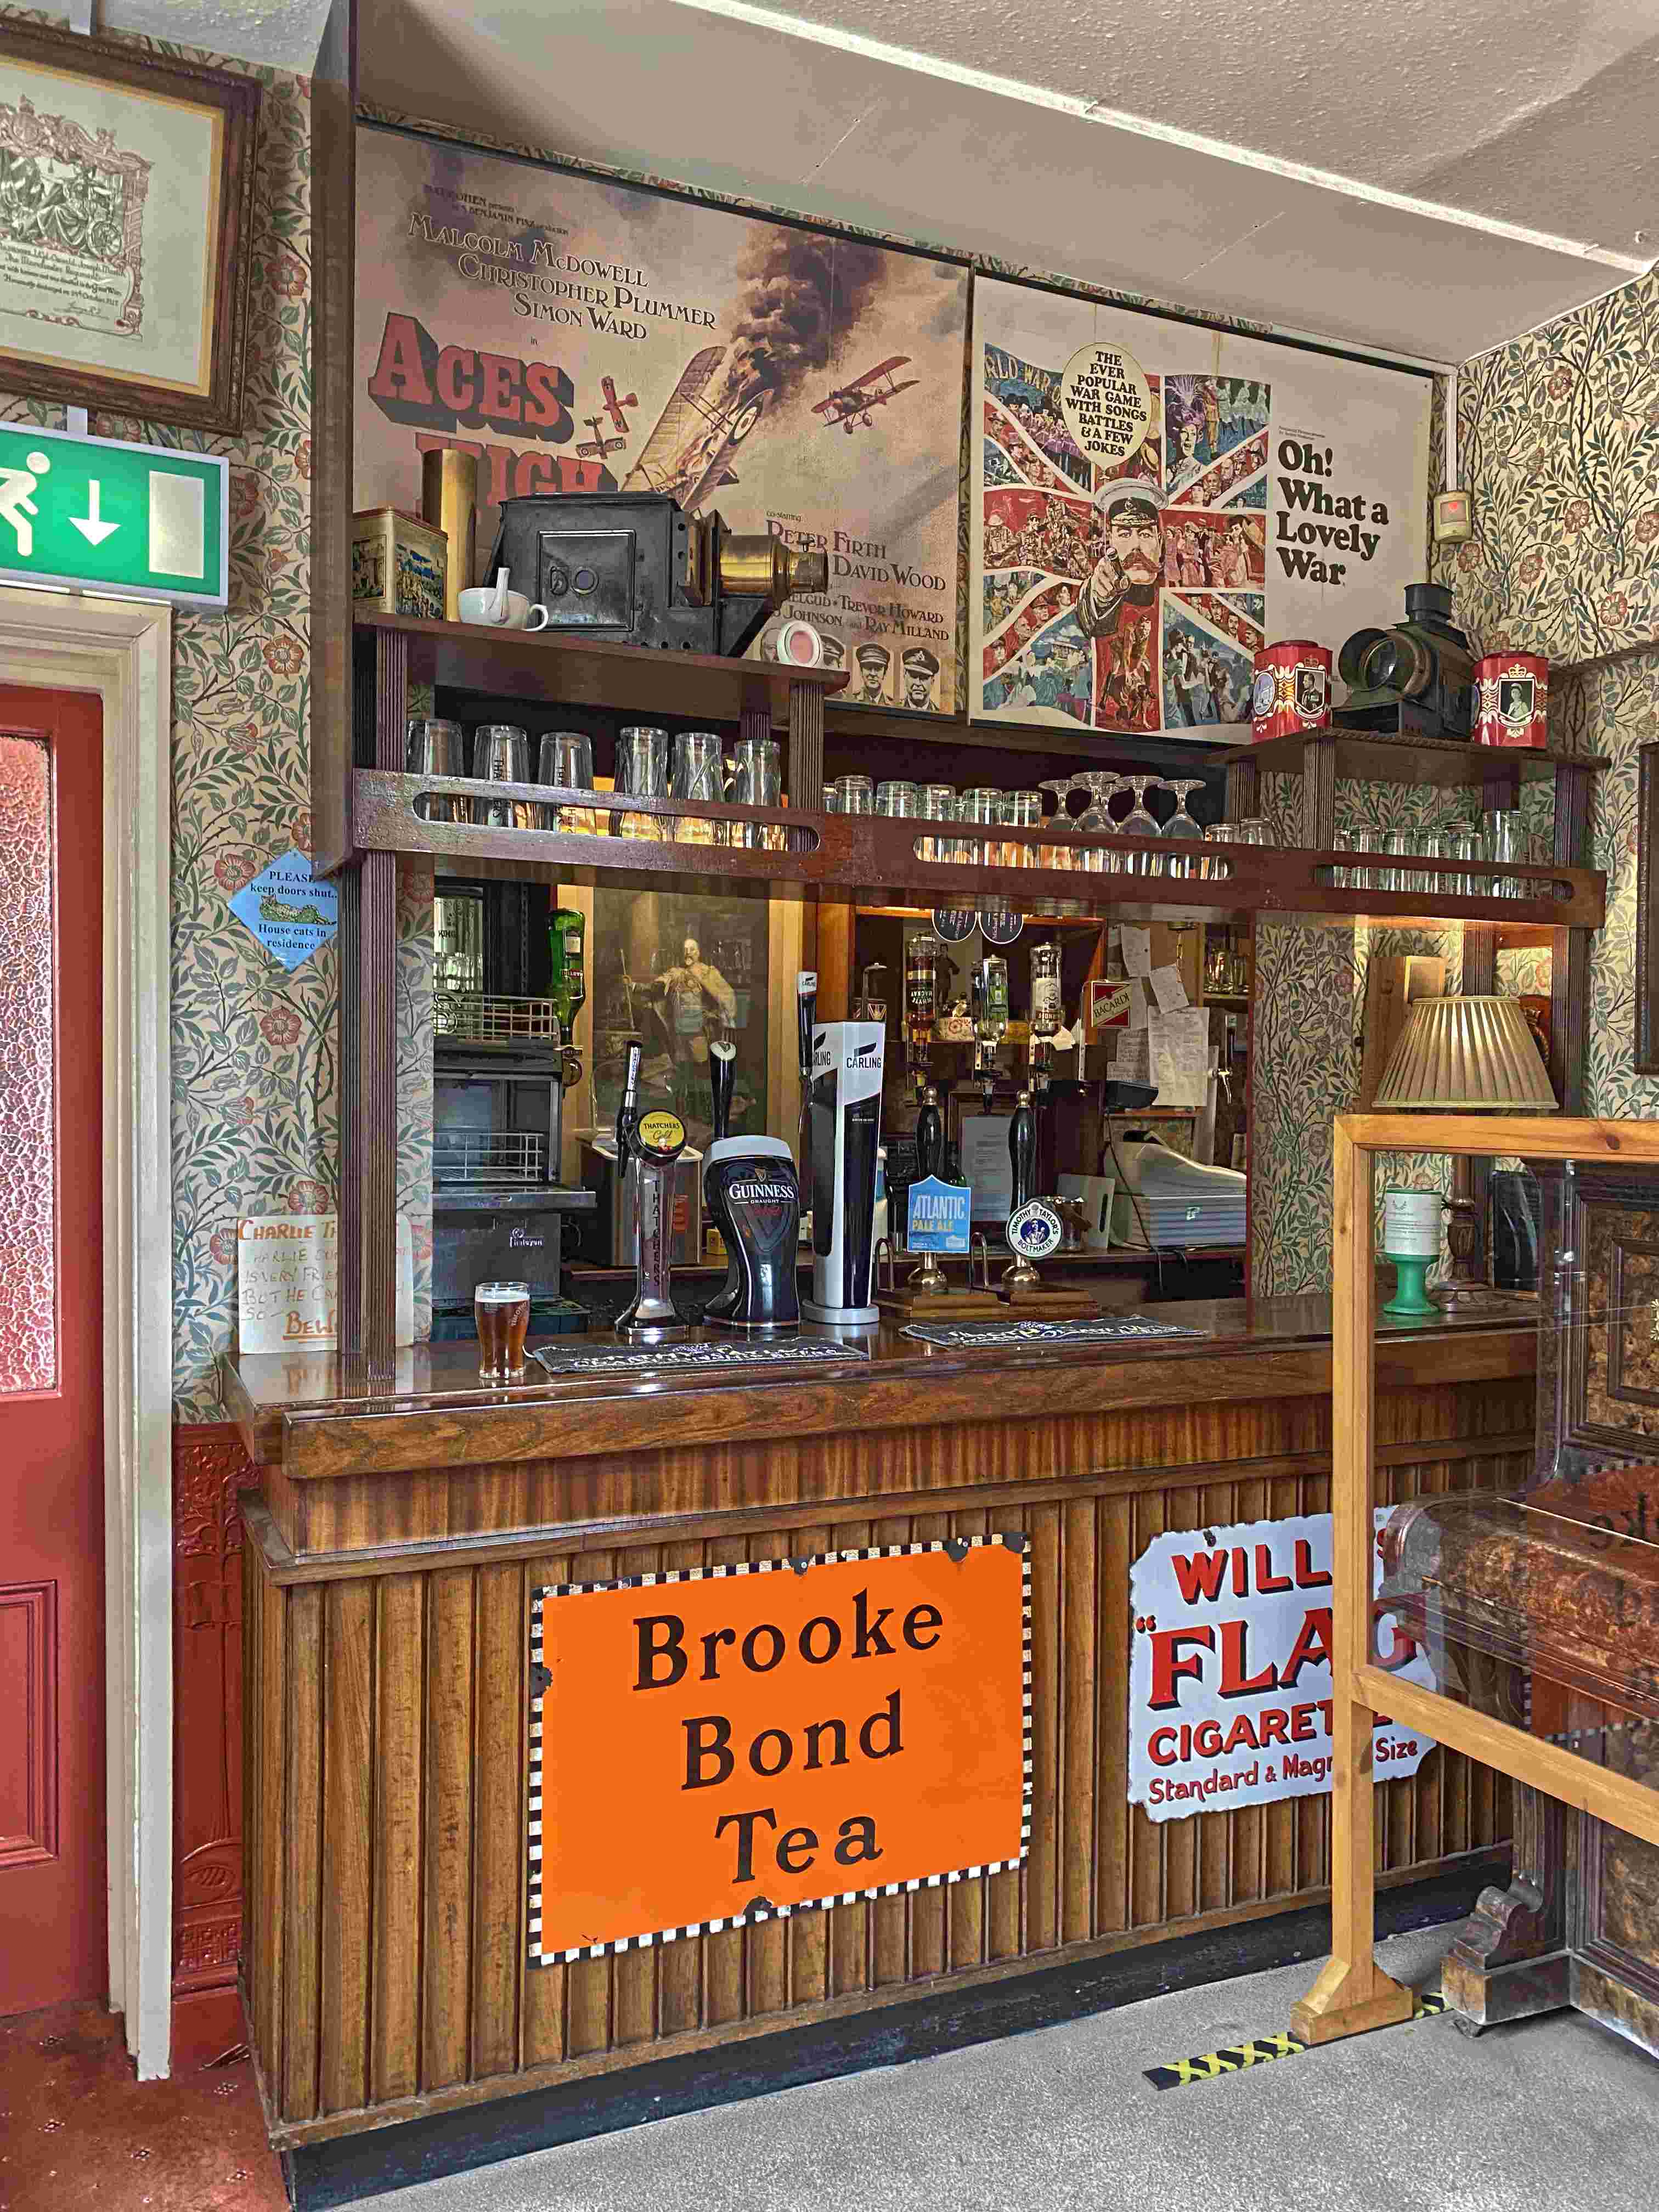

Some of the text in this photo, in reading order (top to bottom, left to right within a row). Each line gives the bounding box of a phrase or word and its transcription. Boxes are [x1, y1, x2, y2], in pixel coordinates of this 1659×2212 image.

[408, 212, 523, 262] MALCOLM
[459, 255, 716, 329] CHRISTOPHER PLUMMER
[514, 293, 647, 340] SIMON WARD
[1096, 351, 1122, 366] THE
[368, 312, 571, 436] ACES
[1090, 363, 1124, 379] EVER
[1077, 374, 1136, 396] POPULAR
[1065, 397, 1147, 421] WITH SONGS
[1070, 386, 1141, 409] WAR GAME
[1079, 413, 1133, 432] BATTLES
[1084, 439, 1125, 456] JOKES
[1105, 431, 1133, 445] FEW
[1278, 439, 1333, 477] Oh!
[1277, 477, 1366, 521] What
[1371, 503, 1389, 525] a
[767, 520, 887, 559] PETER FIRTH
[1276, 511, 1380, 561] Lovely
[833, 555, 945, 590] DAVID WOOD
[1276, 546, 1346, 585] War
[838, 595, 885, 614] TREVOR
[889, 603, 943, 623] HOWARD
[783, 605, 842, 626] JOHNSON
[865, 616, 888, 633] RAY
[893, 623, 949, 641] MILLAND
[251, 883, 274, 895] keep
[278, 885, 306, 895] doors
[259, 924, 326, 937] House cats in
[267, 939, 315, 949] residence
[1094, 993, 1130, 1017] BACARDI
[847, 1057, 882, 1069] CARLING
[729, 1184, 794, 1199] GUINNESS
[913, 1194, 966, 1220] ATLANTIC
[239, 1220, 316, 1239] CHARLIE
[913, 1220, 953, 1231] PALE ALE
[1012, 1209, 1058, 1234] TIMOTHY TAYLOR'S
[1018, 1239, 1053, 1252] BOLTMAKER
[286, 1310, 336, 1334] BEW
[633, 1588, 943, 1691] Brooke
[681, 1688, 904, 1790] Bond
[1149, 1760, 1258, 1804] Standard
[1265, 1765, 1277, 1782] &
[1374, 1736, 1418, 1762] Size
[715, 1808, 883, 1883] Tea
